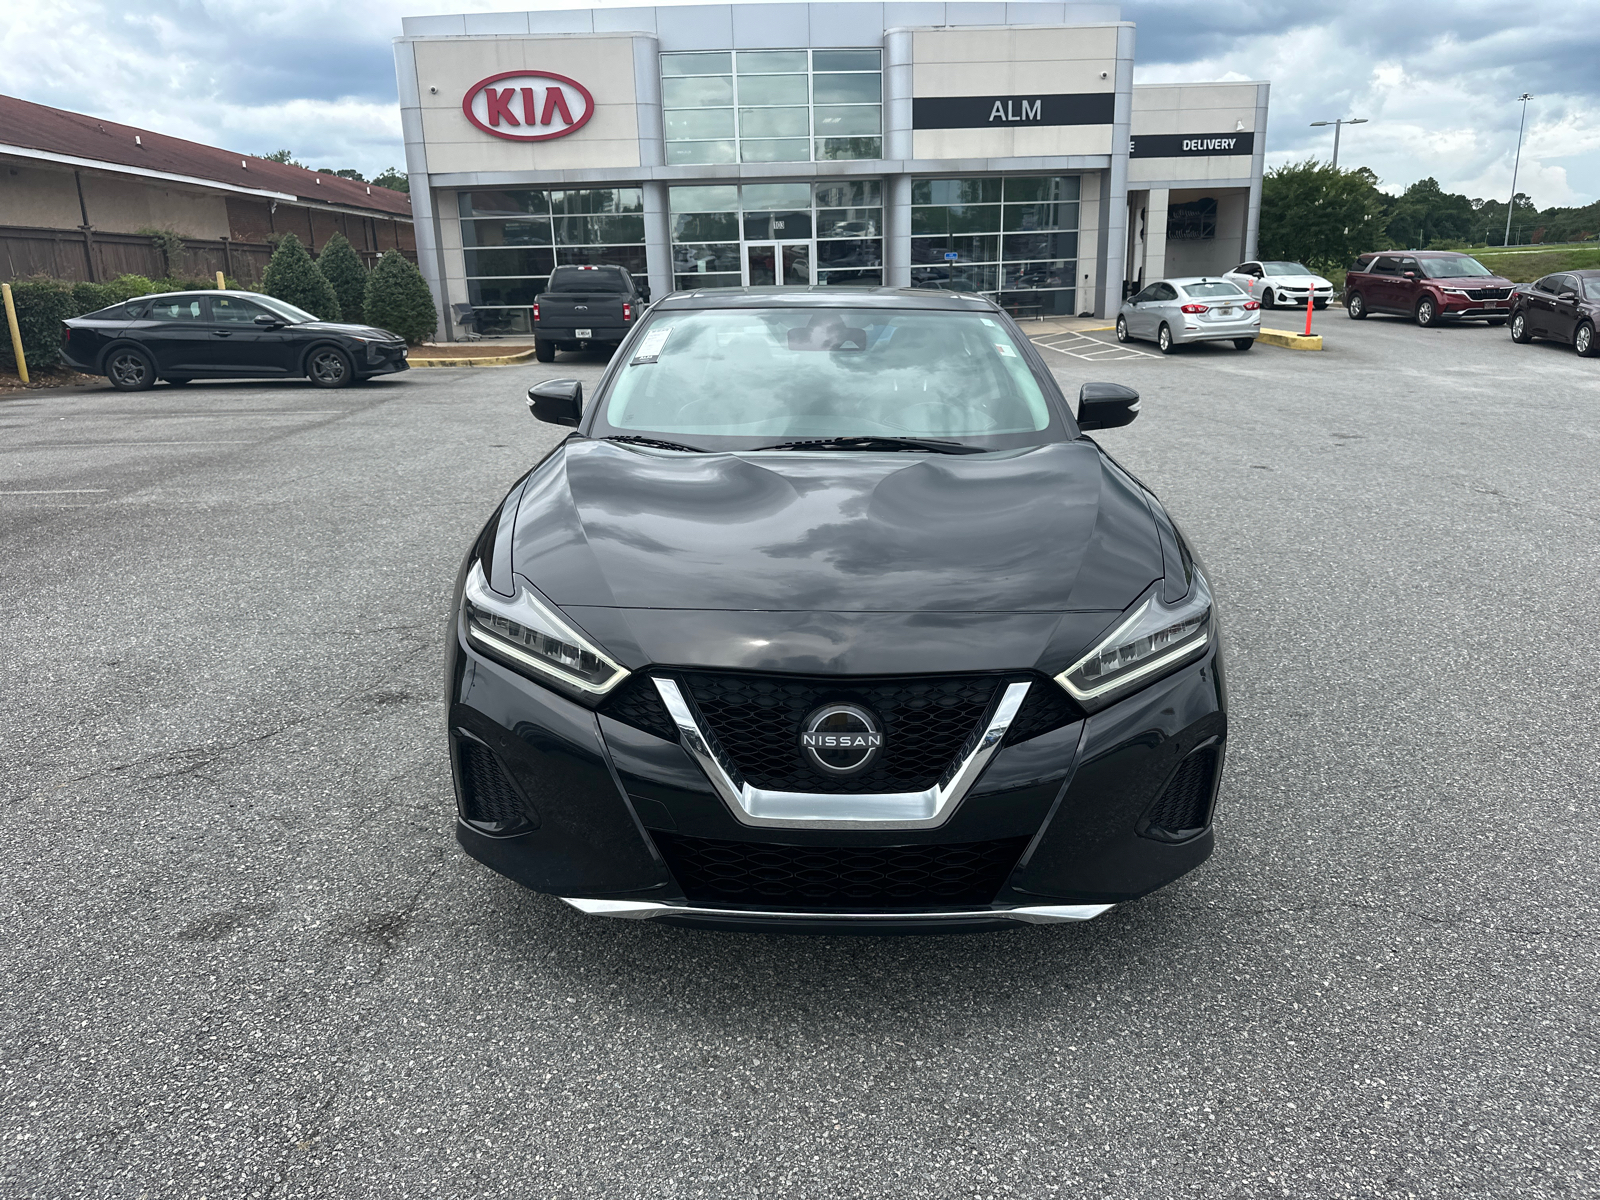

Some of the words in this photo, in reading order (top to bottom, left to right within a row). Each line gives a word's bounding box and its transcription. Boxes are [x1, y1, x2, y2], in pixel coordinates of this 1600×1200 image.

[484, 87, 574, 126] KIA
[988, 99, 1042, 122] ALM
[1182, 138, 1237, 151] DELIVERY
[803, 734, 880, 747] NISSAN
